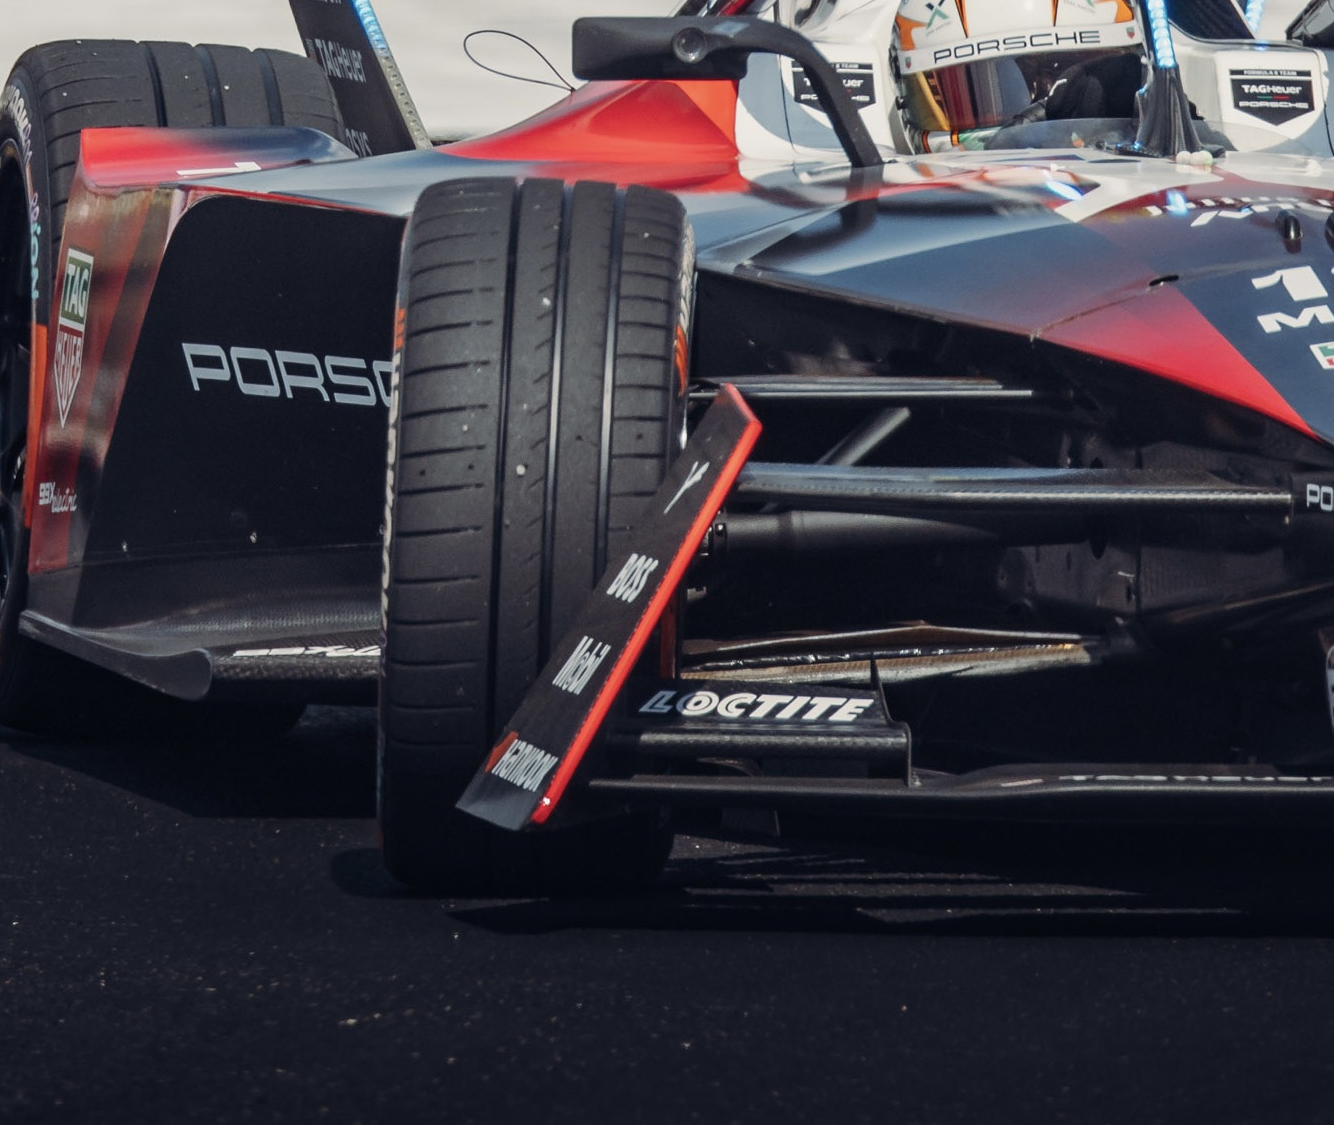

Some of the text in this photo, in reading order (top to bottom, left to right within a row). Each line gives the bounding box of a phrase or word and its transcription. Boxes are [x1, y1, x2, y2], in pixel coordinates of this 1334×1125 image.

[933, 30, 1101, 64] PORSCHE
[1238, 101, 1309, 109] PORSCHE
[1240, 84, 1303, 94] TAGHeuer
[63, 263, 91, 317] TAG
[56, 330, 83, 409] HEUER
[606, 553, 659, 603] BOSS
[552, 635, 612, 696] Mobil
[638, 690, 875, 723] LOCTITE
